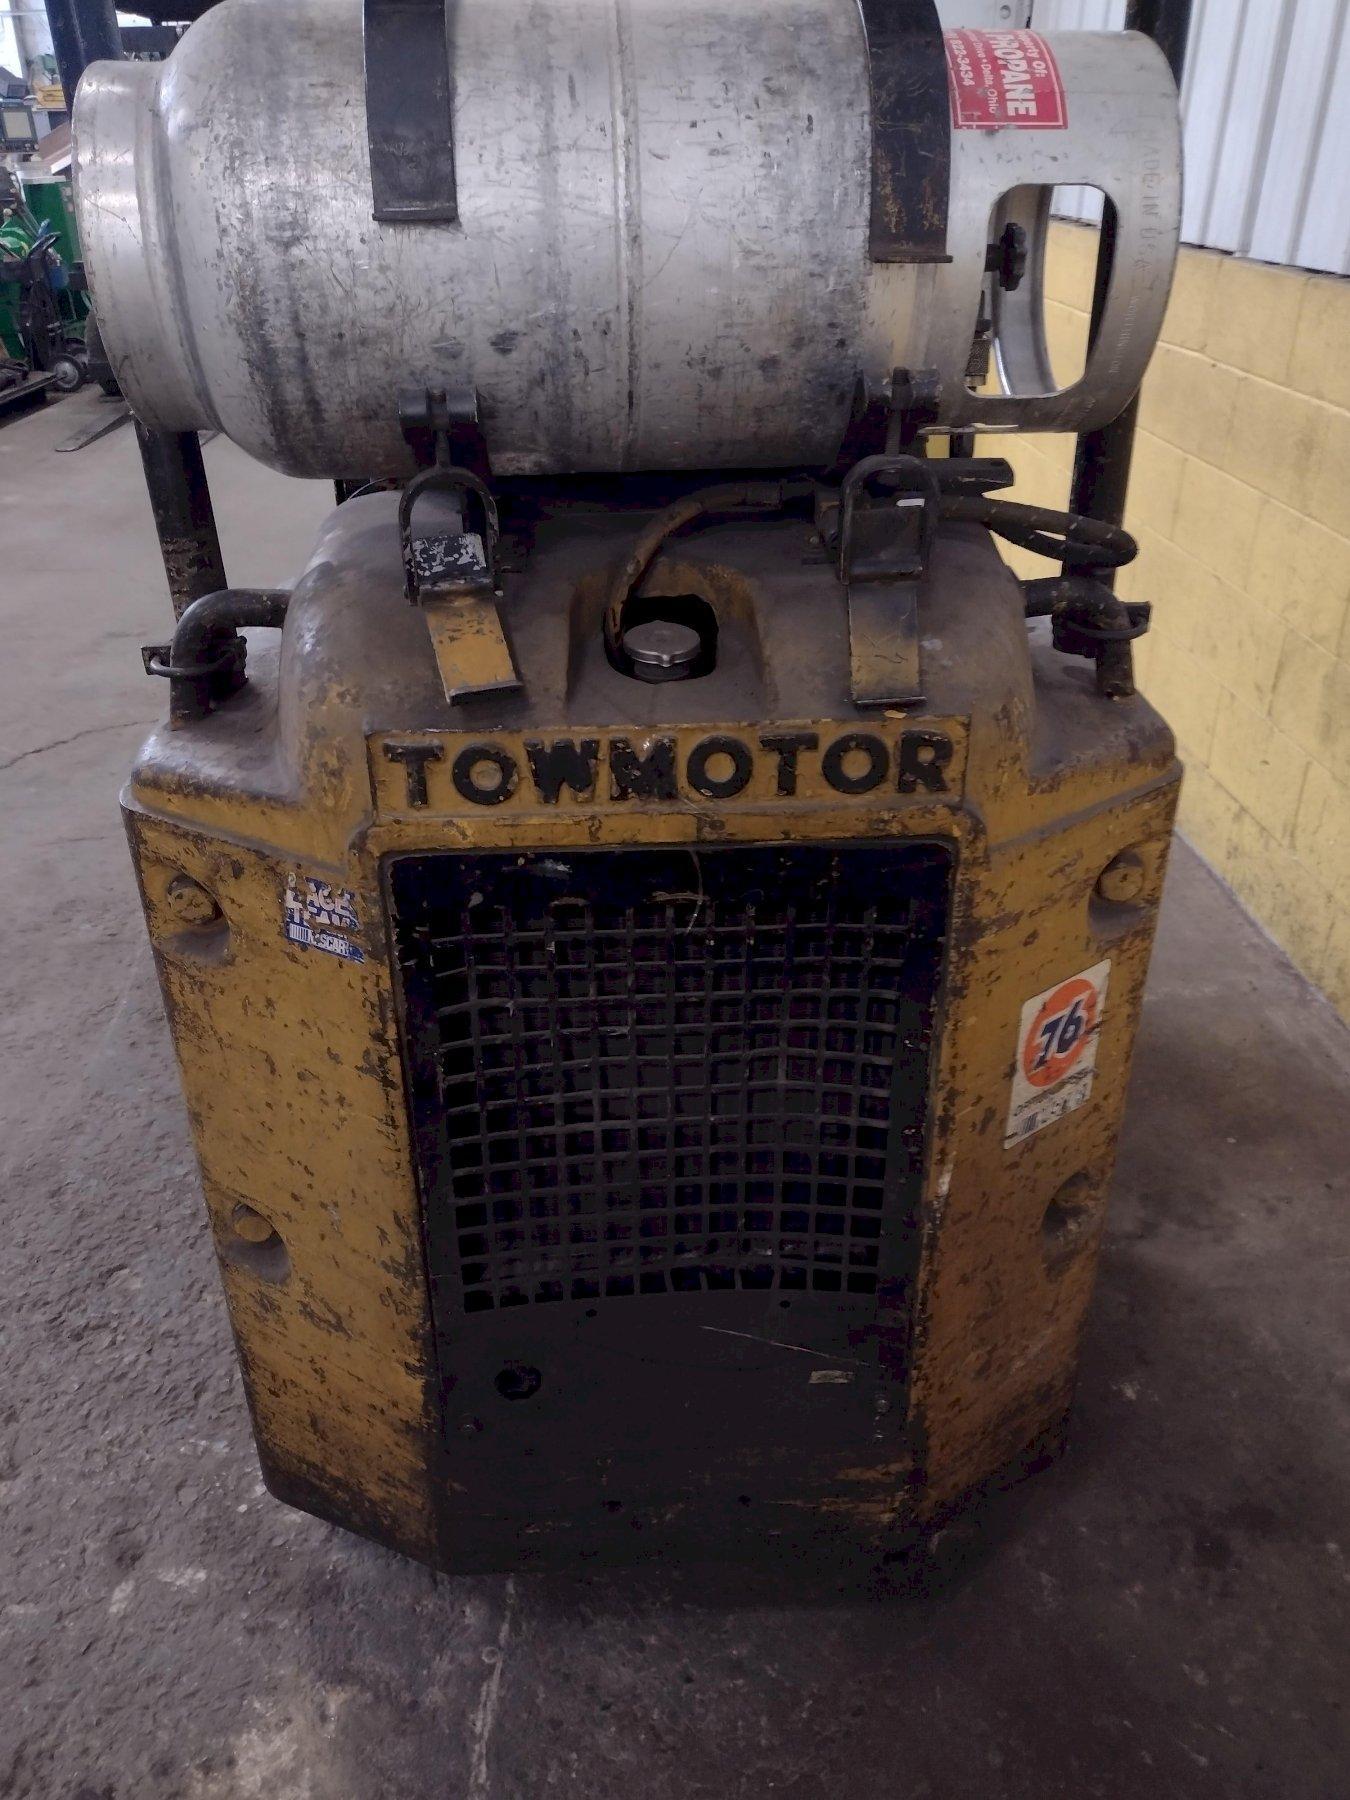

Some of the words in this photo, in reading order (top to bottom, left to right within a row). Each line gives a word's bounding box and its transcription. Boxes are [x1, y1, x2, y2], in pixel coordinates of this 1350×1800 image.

[950, 39, 976, 87] 822-3434
[985, 34, 1038, 116] PROPANE
[987, 88, 1000, 114] Ohio
[1141, 196, 1161, 218] IN
[383, 729, 955, 808] TOWMOTOR
[308, 931, 350, 957] NSCAR
[1032, 998, 1085, 1071] 76
